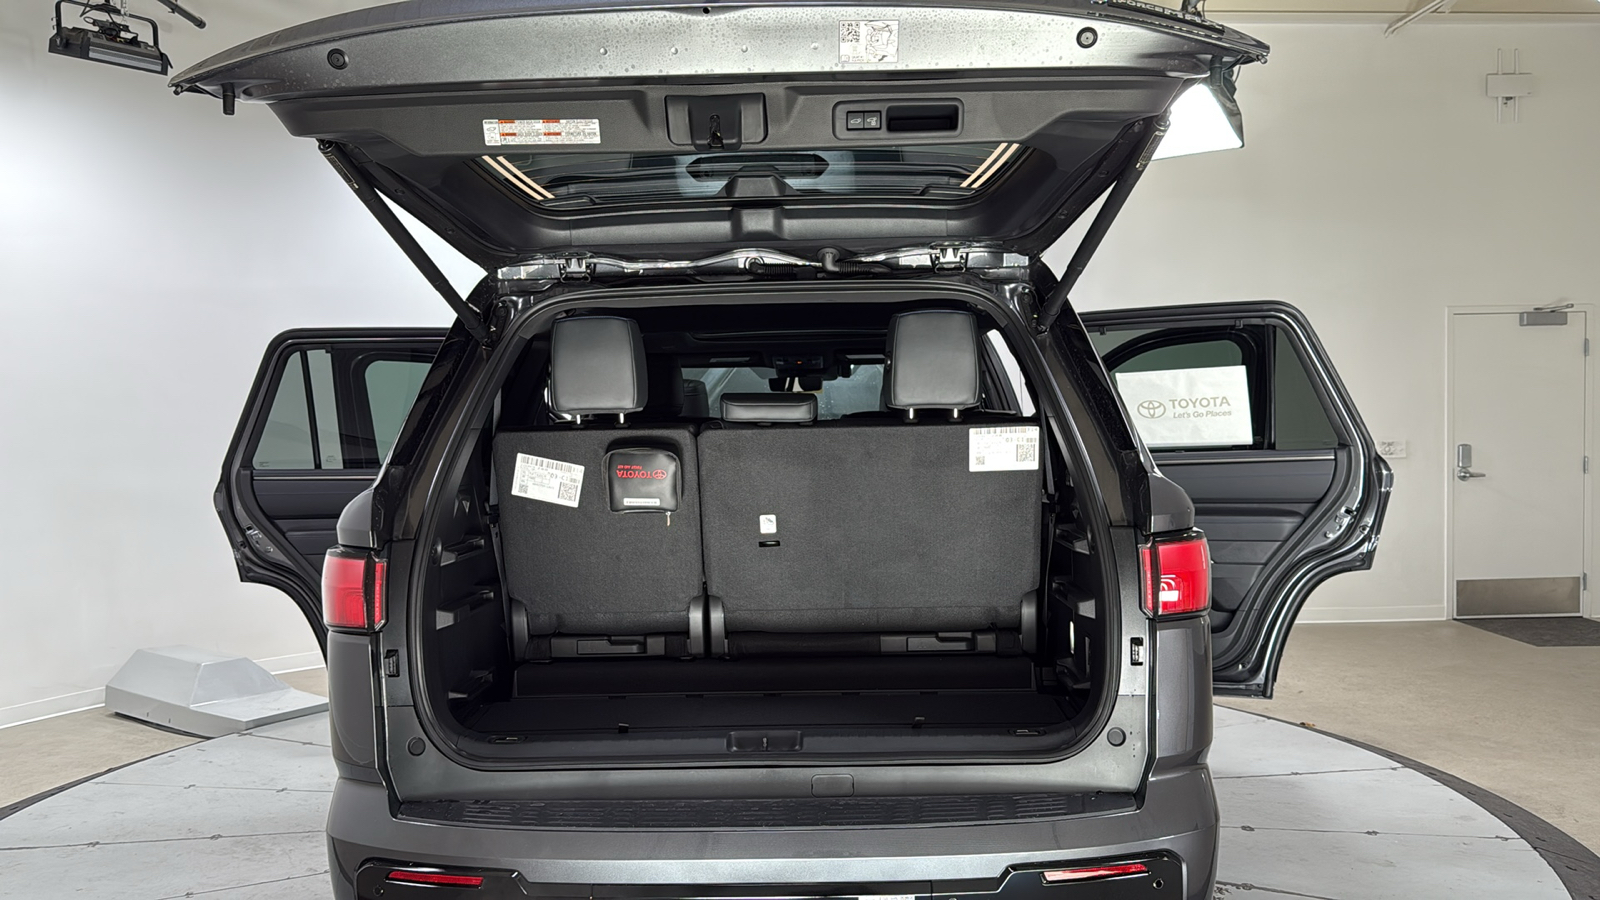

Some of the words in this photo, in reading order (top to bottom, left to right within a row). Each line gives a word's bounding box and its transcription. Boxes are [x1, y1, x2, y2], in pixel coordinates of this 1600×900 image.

[1168, 396, 1231, 410] TOYOTA
[1173, 411, 1190, 419] Let's
[1205, 410, 1232, 418] Places
[616, 470, 652, 479] TOYOTA
